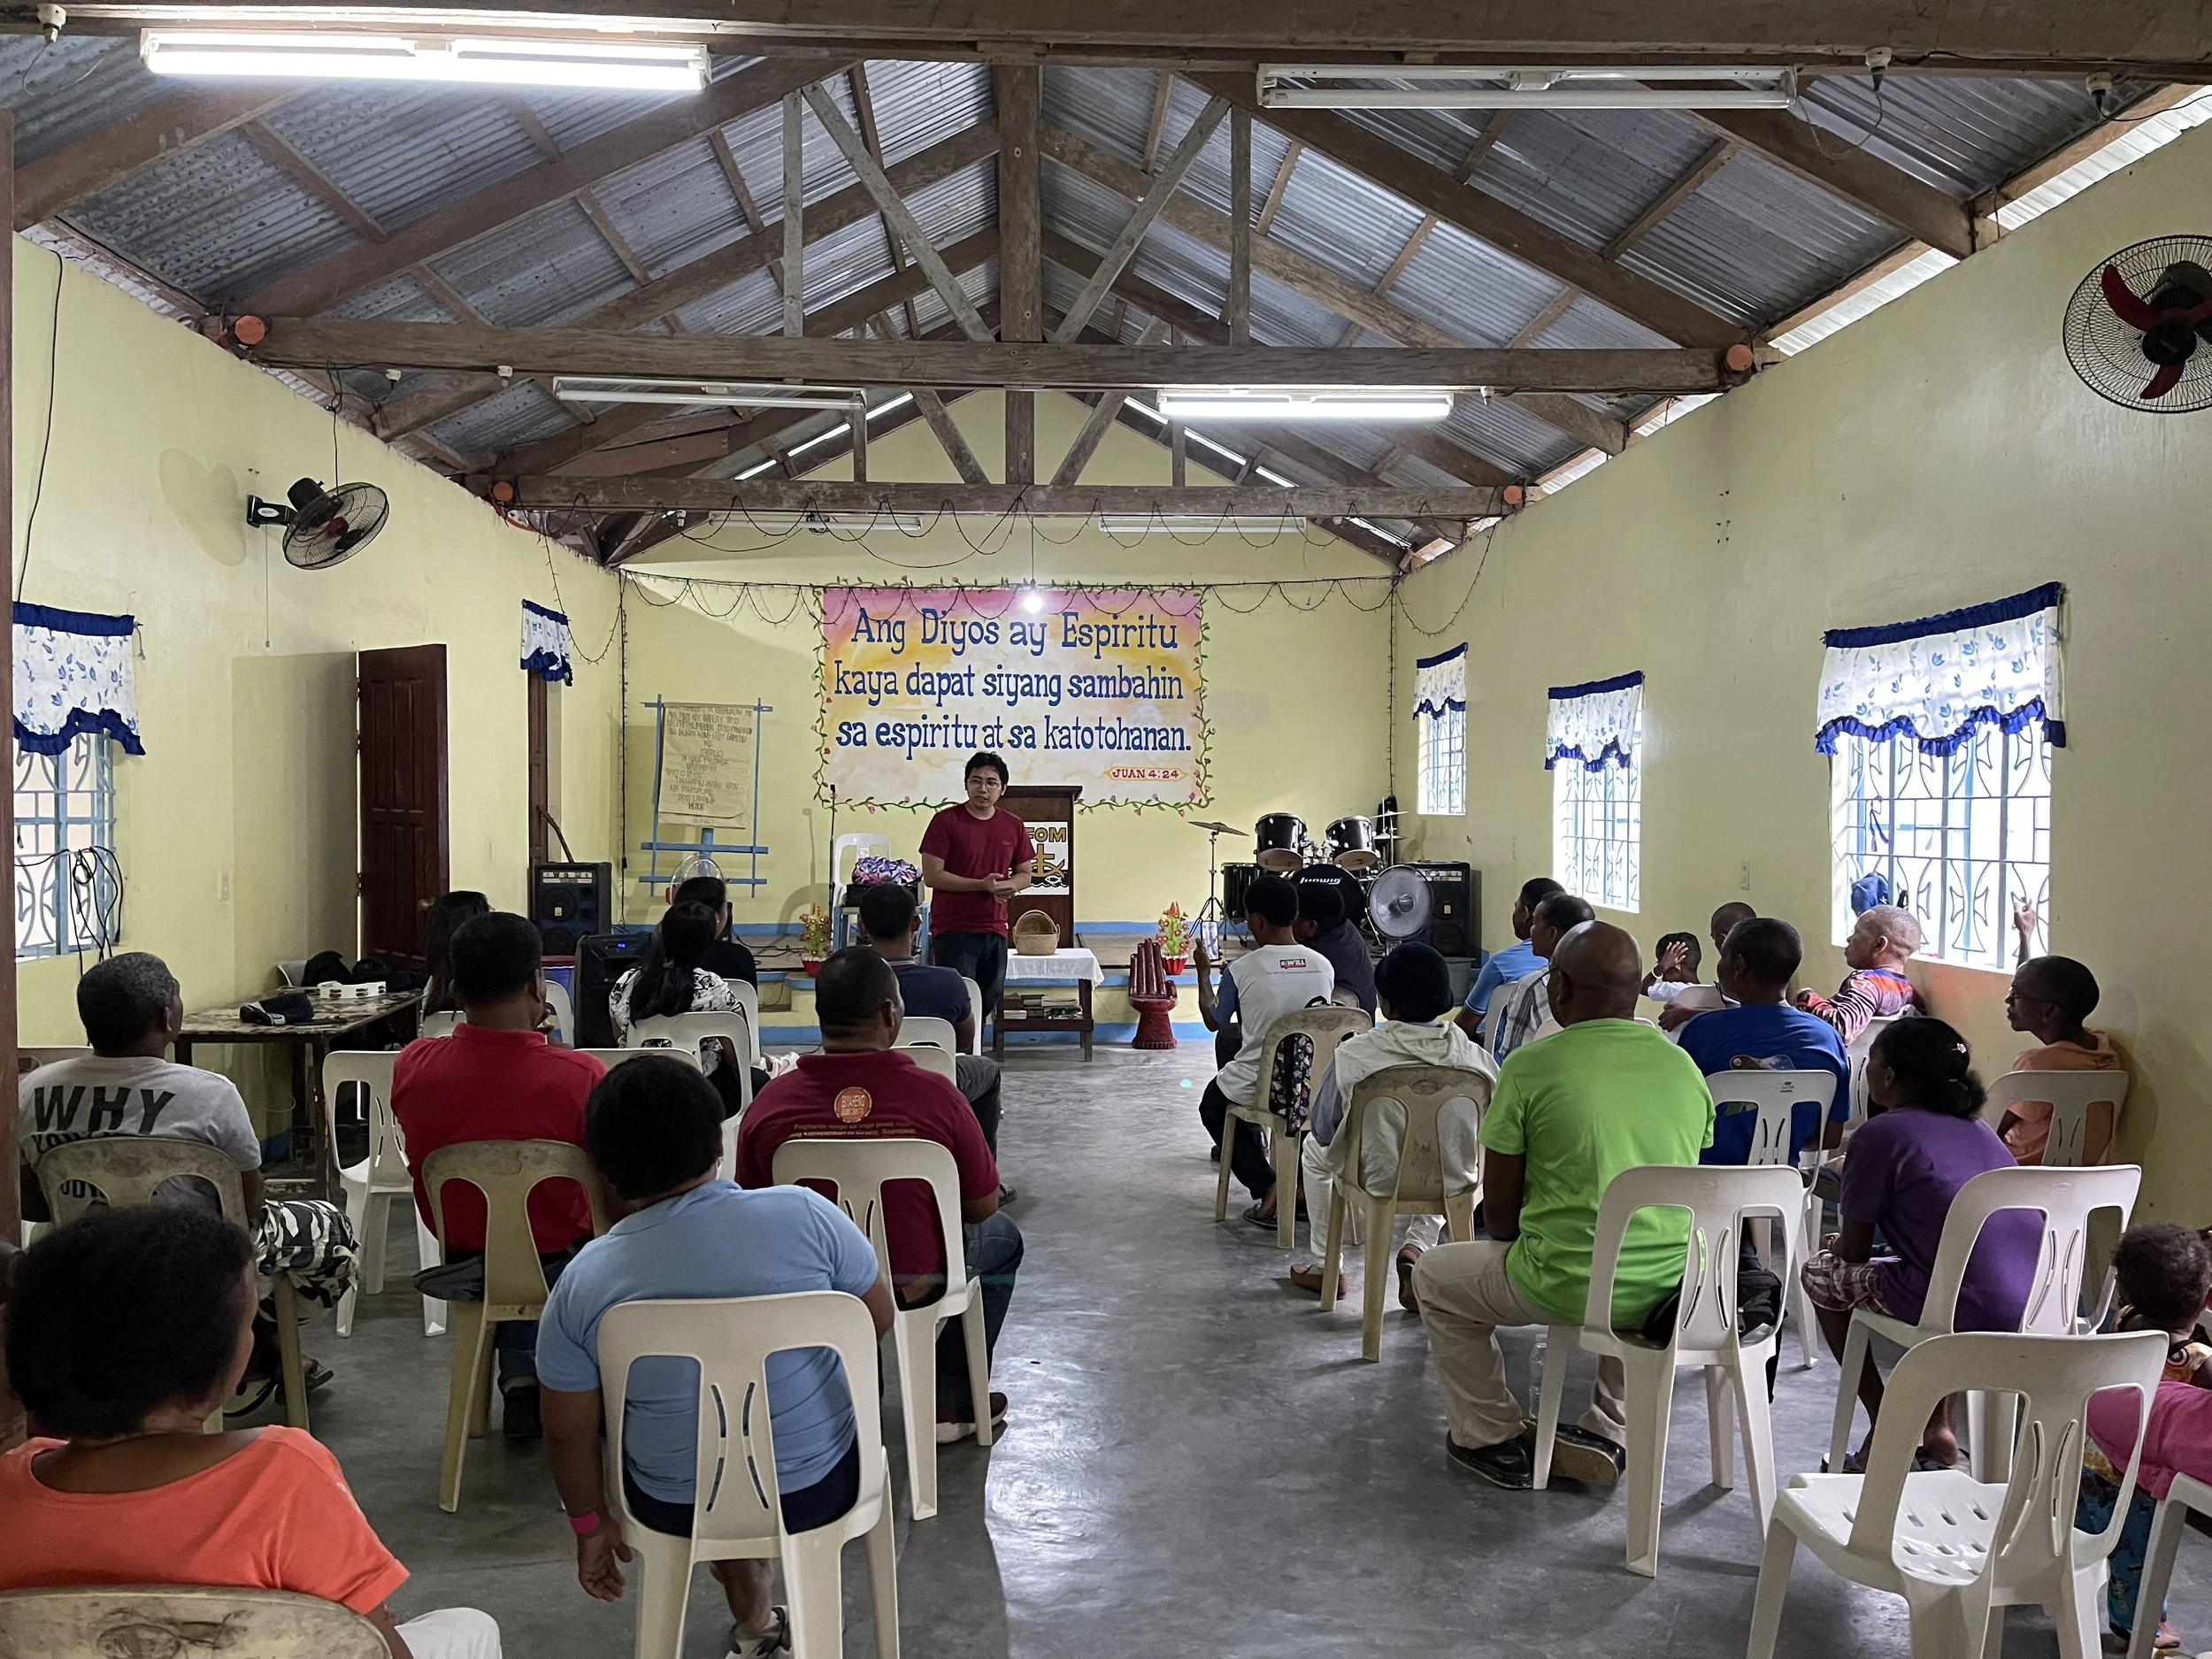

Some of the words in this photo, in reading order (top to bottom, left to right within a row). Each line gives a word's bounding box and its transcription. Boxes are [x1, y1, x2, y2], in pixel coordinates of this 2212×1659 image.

[850, 608, 906, 655] Ang
[921, 608, 1000, 656] Diyos
[1010, 621, 1047, 657] ay
[1062, 611, 1178, 659] Espiritu
[834, 660, 899, 706] kaya
[906, 662, 975, 707] dapat
[982, 664, 1062, 707] siyang
[1066, 665, 1184, 700] sambahin
[835, 718, 867, 748] sa
[875, 714, 978, 760] espiritu
[982, 718, 1004, 749] at
[1008, 724, 1037, 749] sa
[1044, 716, 1192, 752] katotohanan.
[1112, 769, 1146, 780] JUAN
[1148, 769, 1179, 780] 4:24
[34, 1085, 176, 1135] WHY
